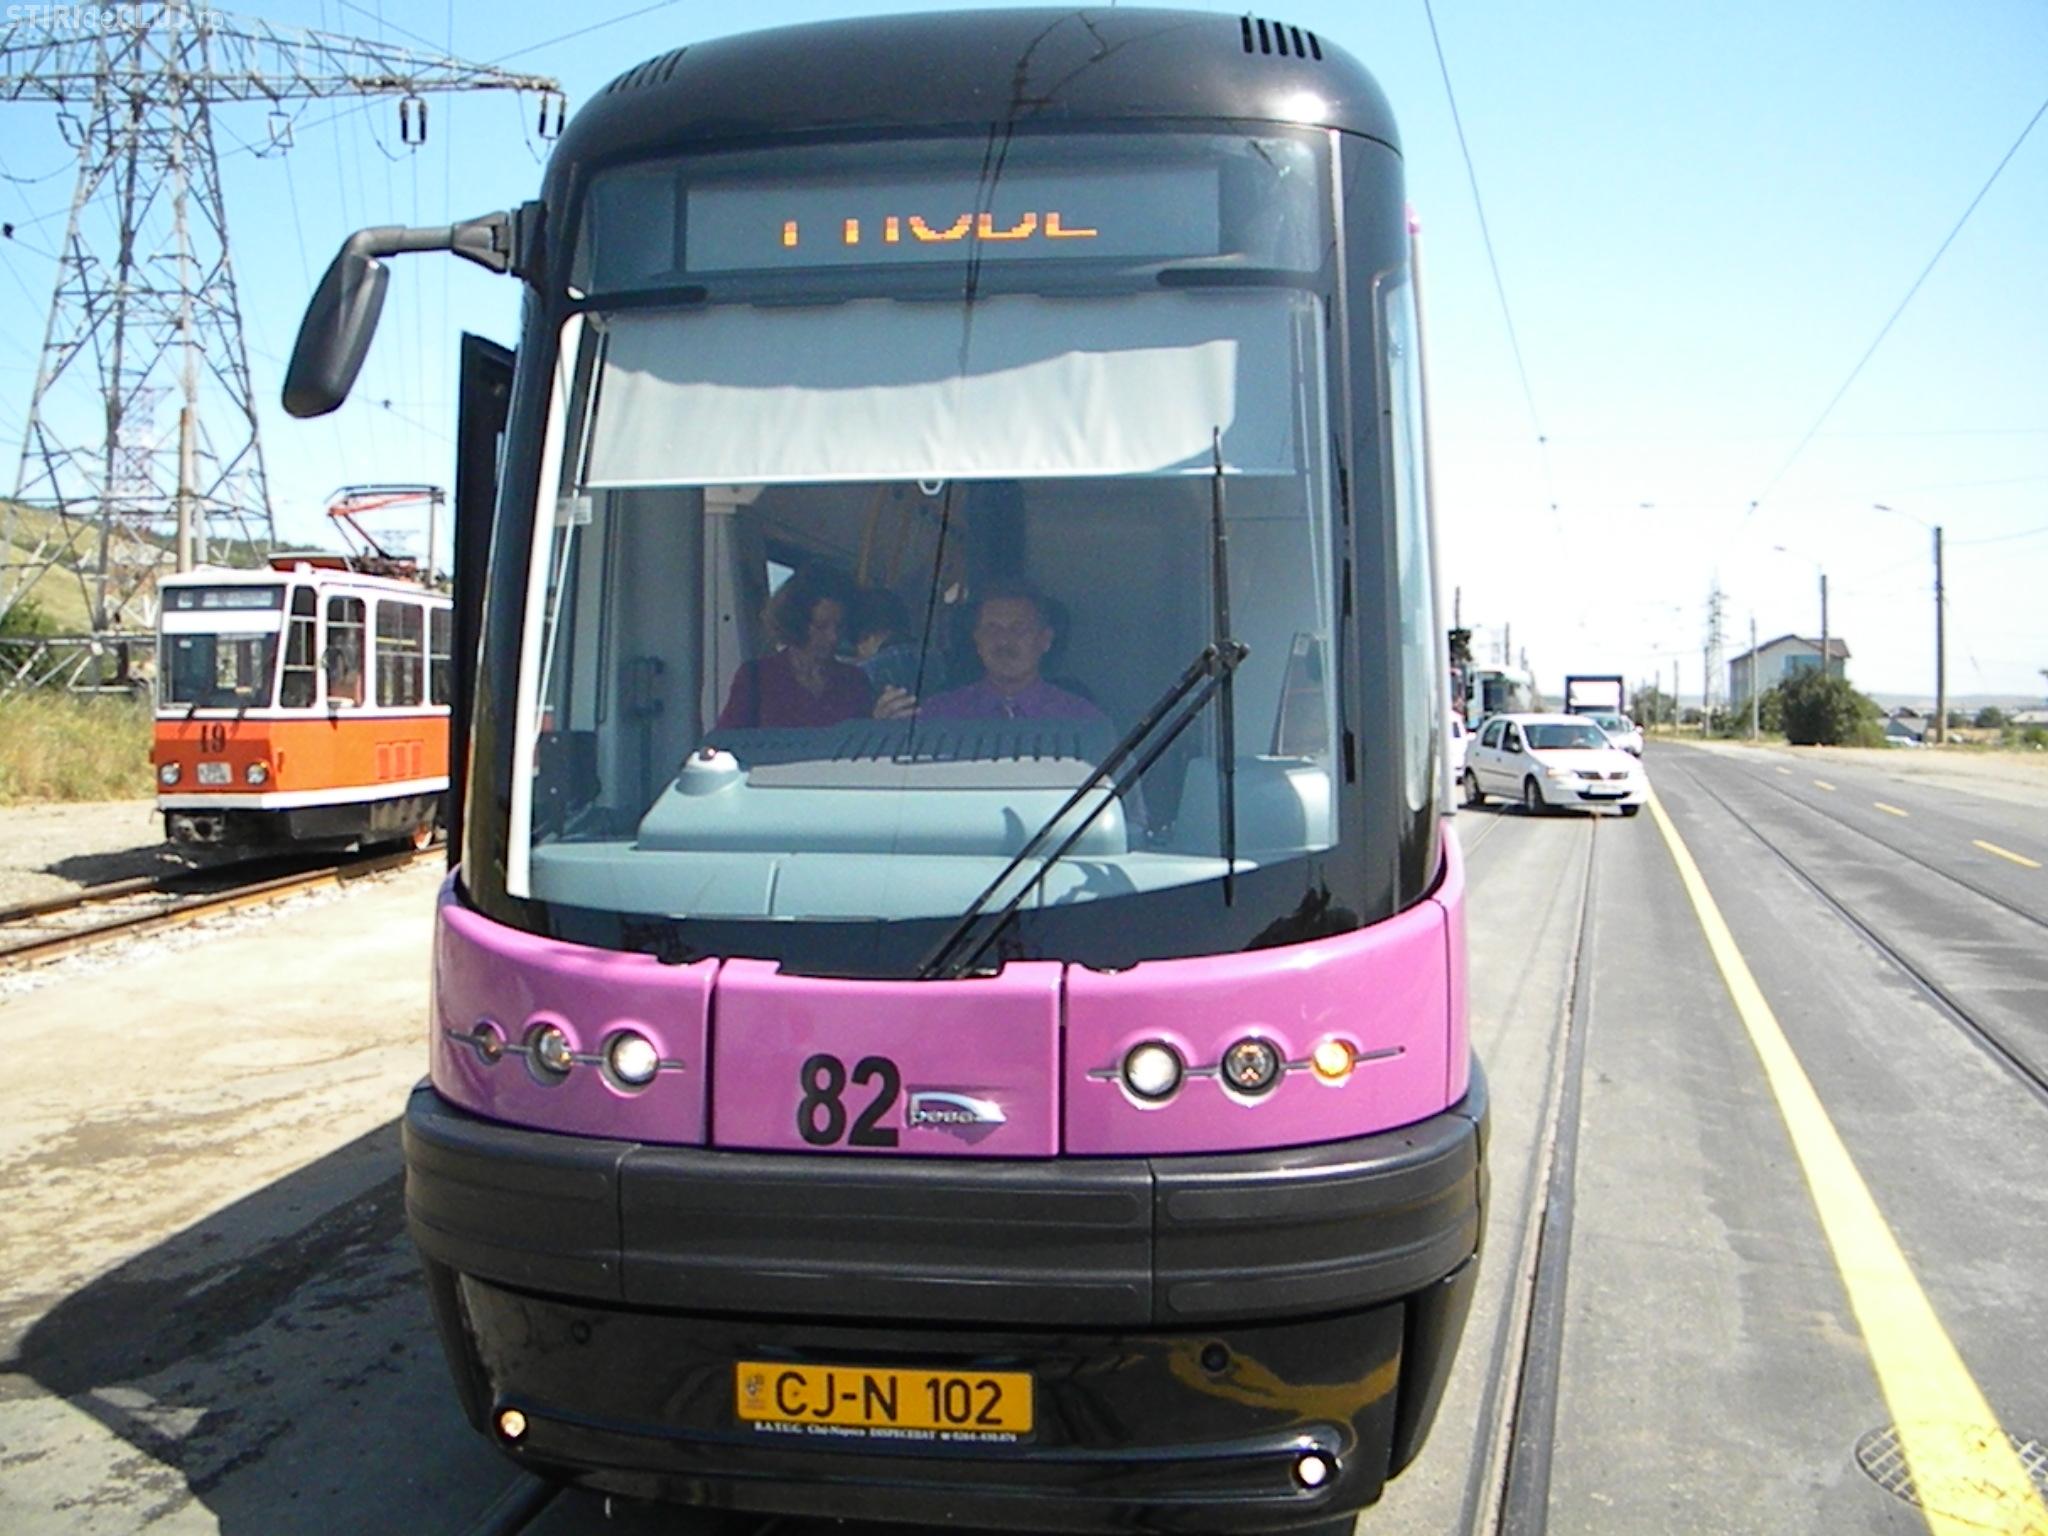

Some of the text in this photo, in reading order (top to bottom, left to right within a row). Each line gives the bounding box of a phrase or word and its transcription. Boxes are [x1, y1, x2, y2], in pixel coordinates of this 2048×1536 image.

[797, 1053, 900, 1147] 82
[775, 1371, 1003, 1425] CJ-N 102
